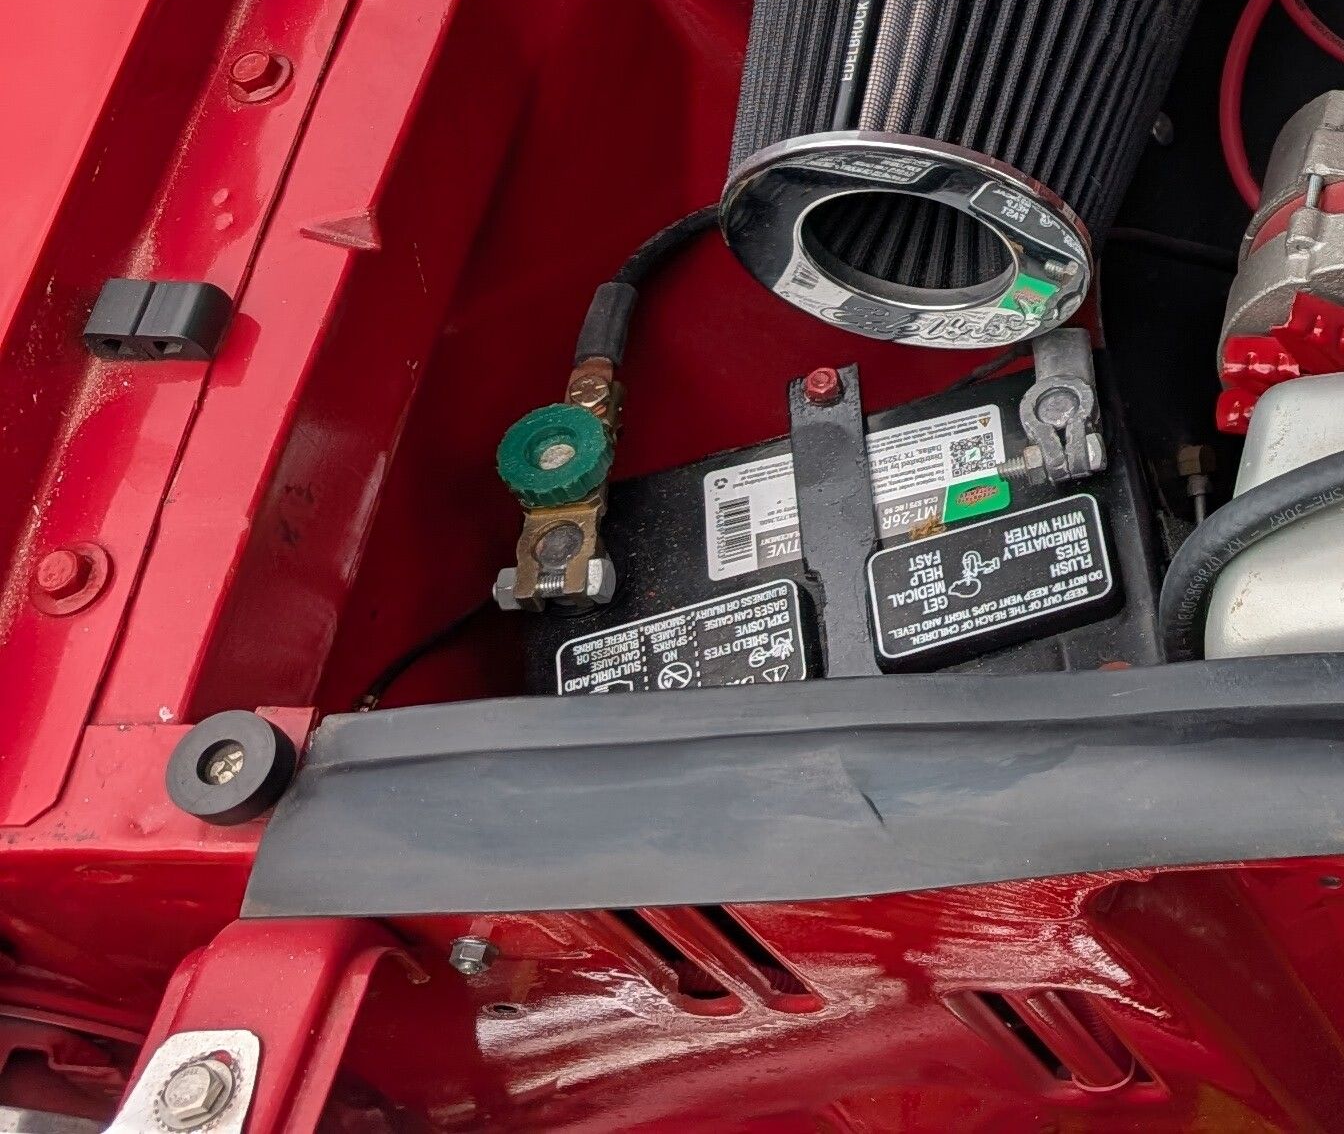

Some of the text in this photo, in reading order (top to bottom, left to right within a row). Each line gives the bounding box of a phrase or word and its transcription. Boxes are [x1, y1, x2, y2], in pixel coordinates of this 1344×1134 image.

[882, 505, 938, 529] MT-26R
[1003, 510, 1085, 544] WITH WATER
[1002, 524, 1087, 561] IMMEDIATELY
[1055, 538, 1090, 560] EYES
[908, 550, 941, 571] FAST
[1050, 553, 1093, 578] FLUSH
[909, 564, 943, 586] HELP
[1069, 573, 1087, 586] NOT
[1087, 569, 1103, 582] DO
[887, 579, 946, 607] MEDICAL
[999, 591, 1022, 606] VENT
[1024, 585, 1048, 599] KEEP
[1043, 591, 1064, 605] OUT
[1064, 586, 1087, 599] KEEP
[693, 585, 787, 621] BLINDNESS OR INJURY
[921, 594, 948, 615] GET
[971, 600, 998, 616] CAPS
[1007, 603, 1026, 616] THE
[1027, 599, 1041, 610] OF
[643, 614, 686, 635] SMOKING
[704, 598, 788, 631] GASES CAN CAUSE
[734, 611, 790, 636] EXPLOSIVE
[922, 616, 942, 629] AND
[943, 607, 969, 622] TIGHT
[975, 609, 1007, 626] REACH
[650, 625, 687, 643] FLAMES
[960, 620, 973, 631] OF
[572, 628, 638, 655] SEVERE BURNS
[576, 639, 640, 665] BLINDNESS OR
[653, 635, 688, 653] SPARKS
[703, 632, 769, 660] SHIELD EYES
[590, 650, 640, 671] CAN CAUSE
[662, 649, 678, 663] NO
[564, 660, 641, 692] SULFURIC ACID
